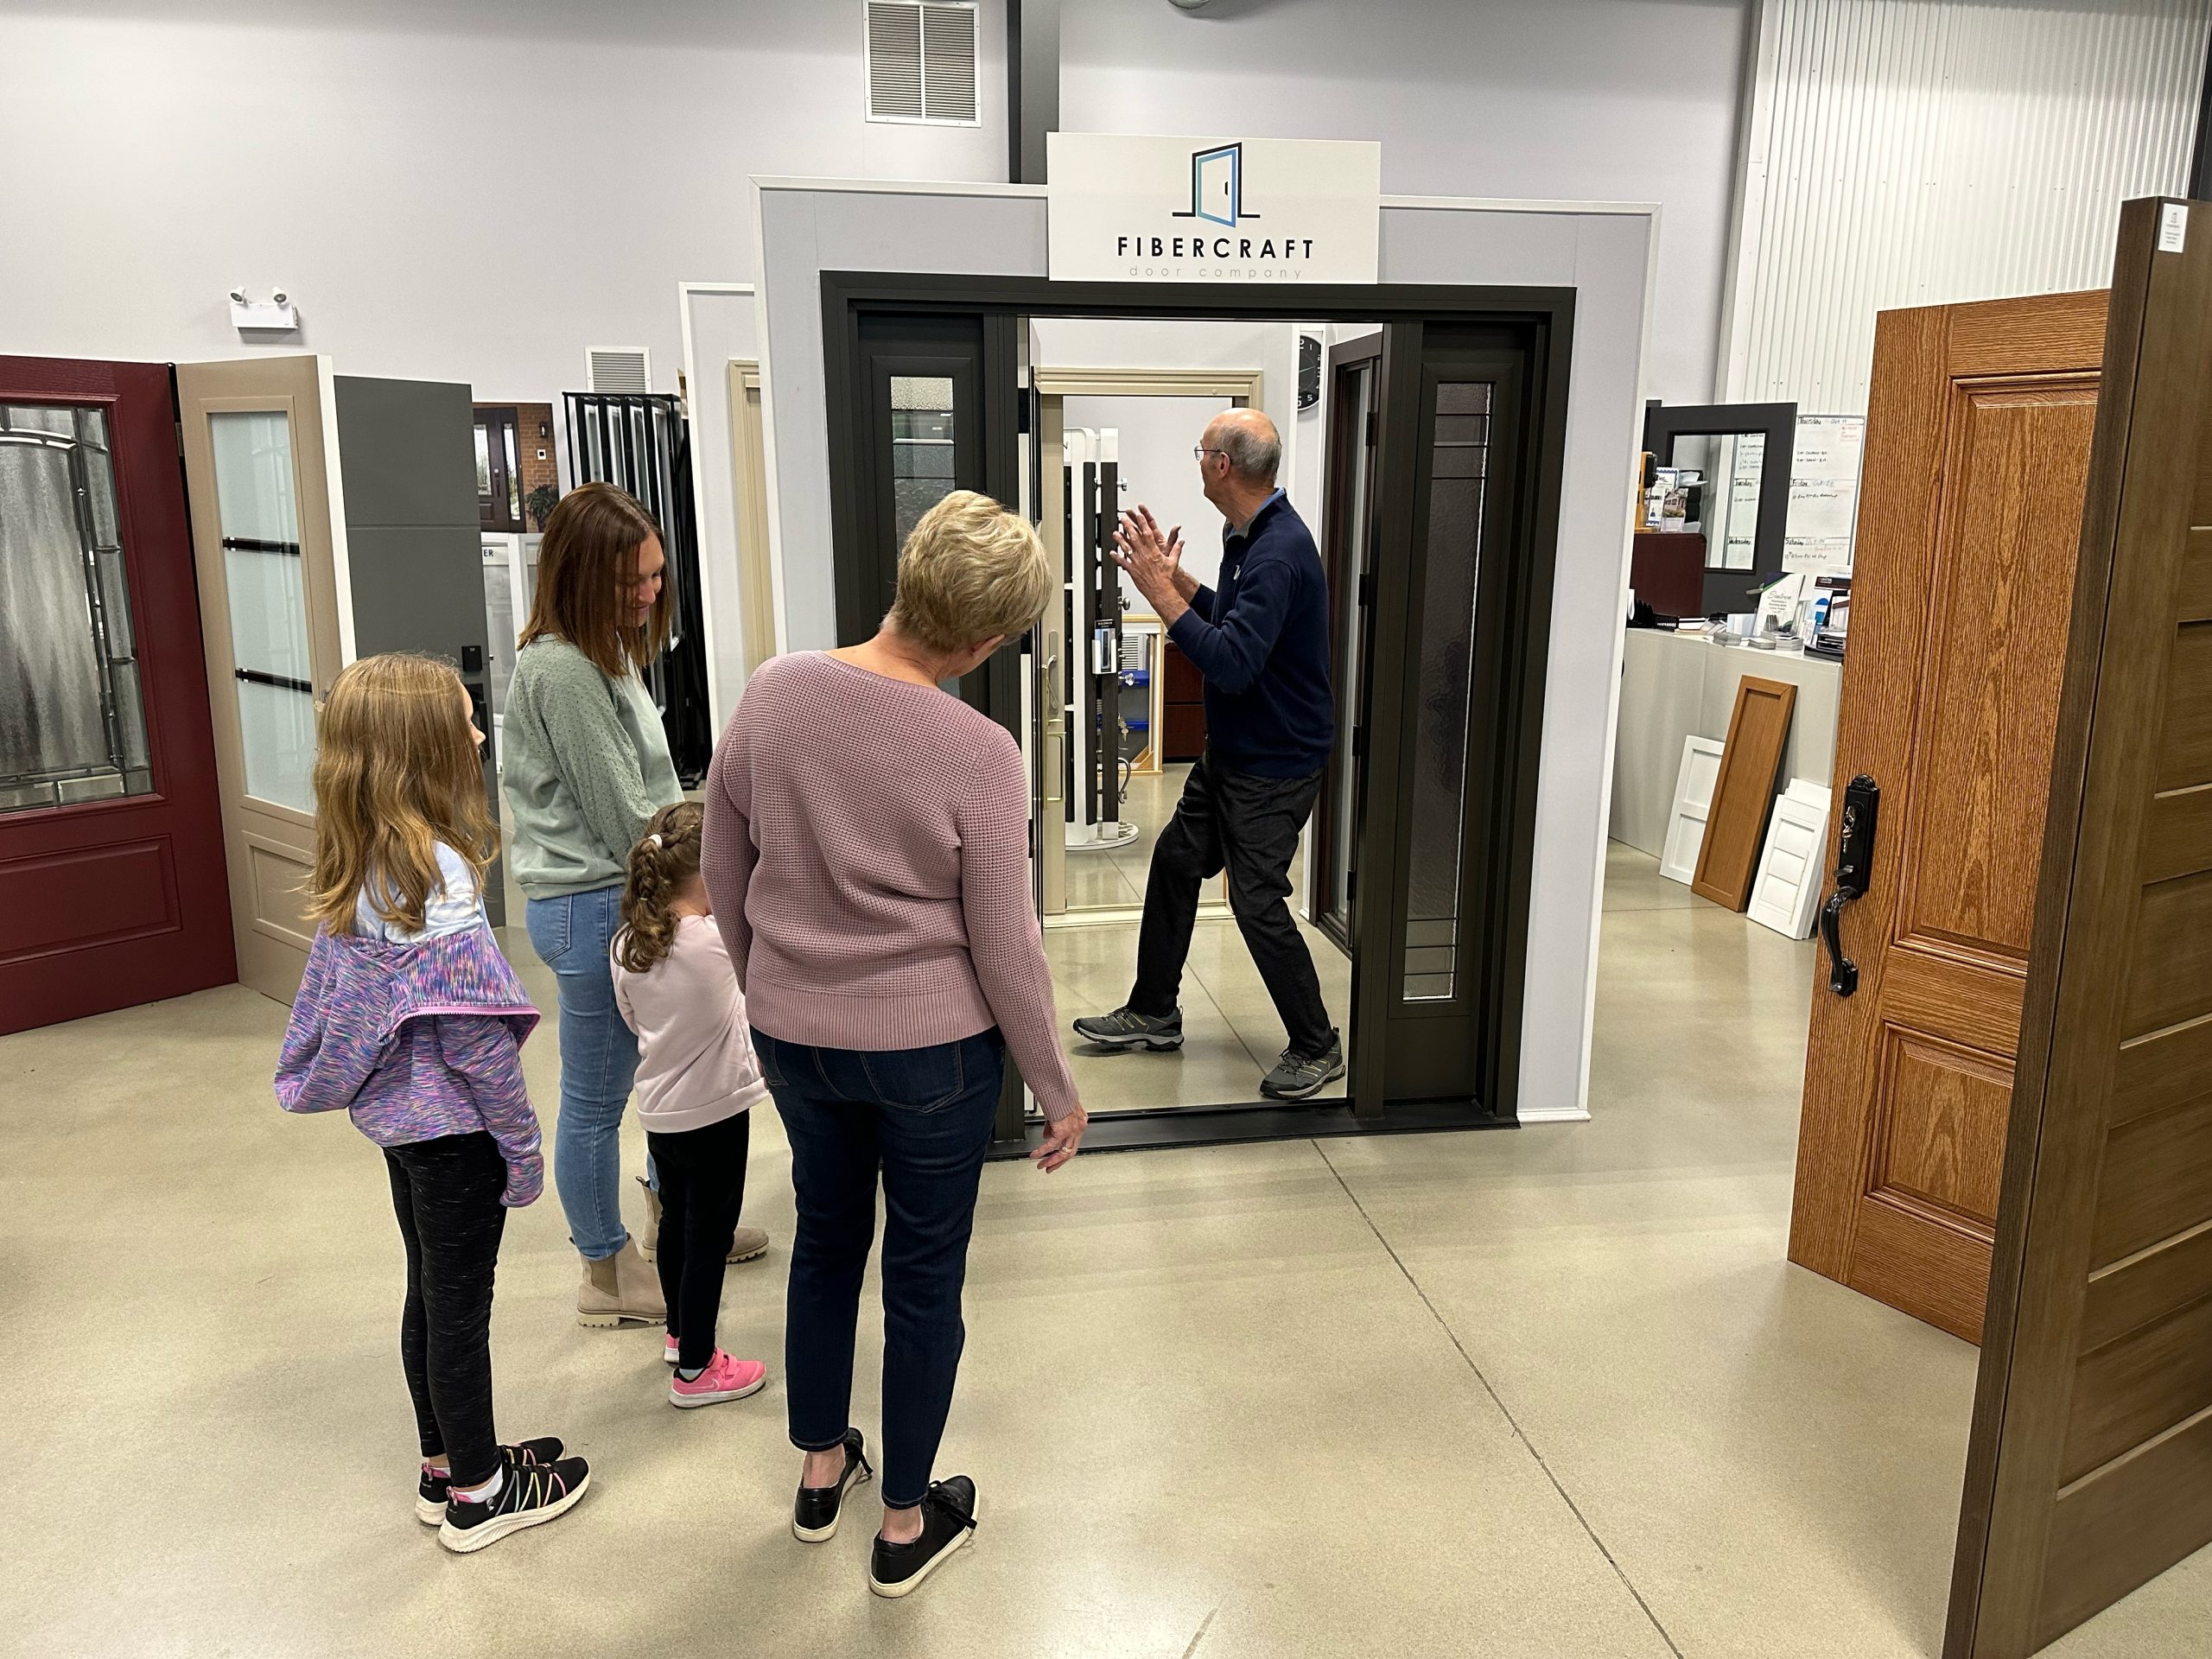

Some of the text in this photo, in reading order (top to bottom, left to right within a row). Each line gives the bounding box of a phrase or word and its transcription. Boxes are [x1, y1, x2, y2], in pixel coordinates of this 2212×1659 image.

[1118, 237, 1313, 258] FIBERCRAFT
[1129, 264, 1301, 280] door company
[1792, 479, 1808, 487] Friday
